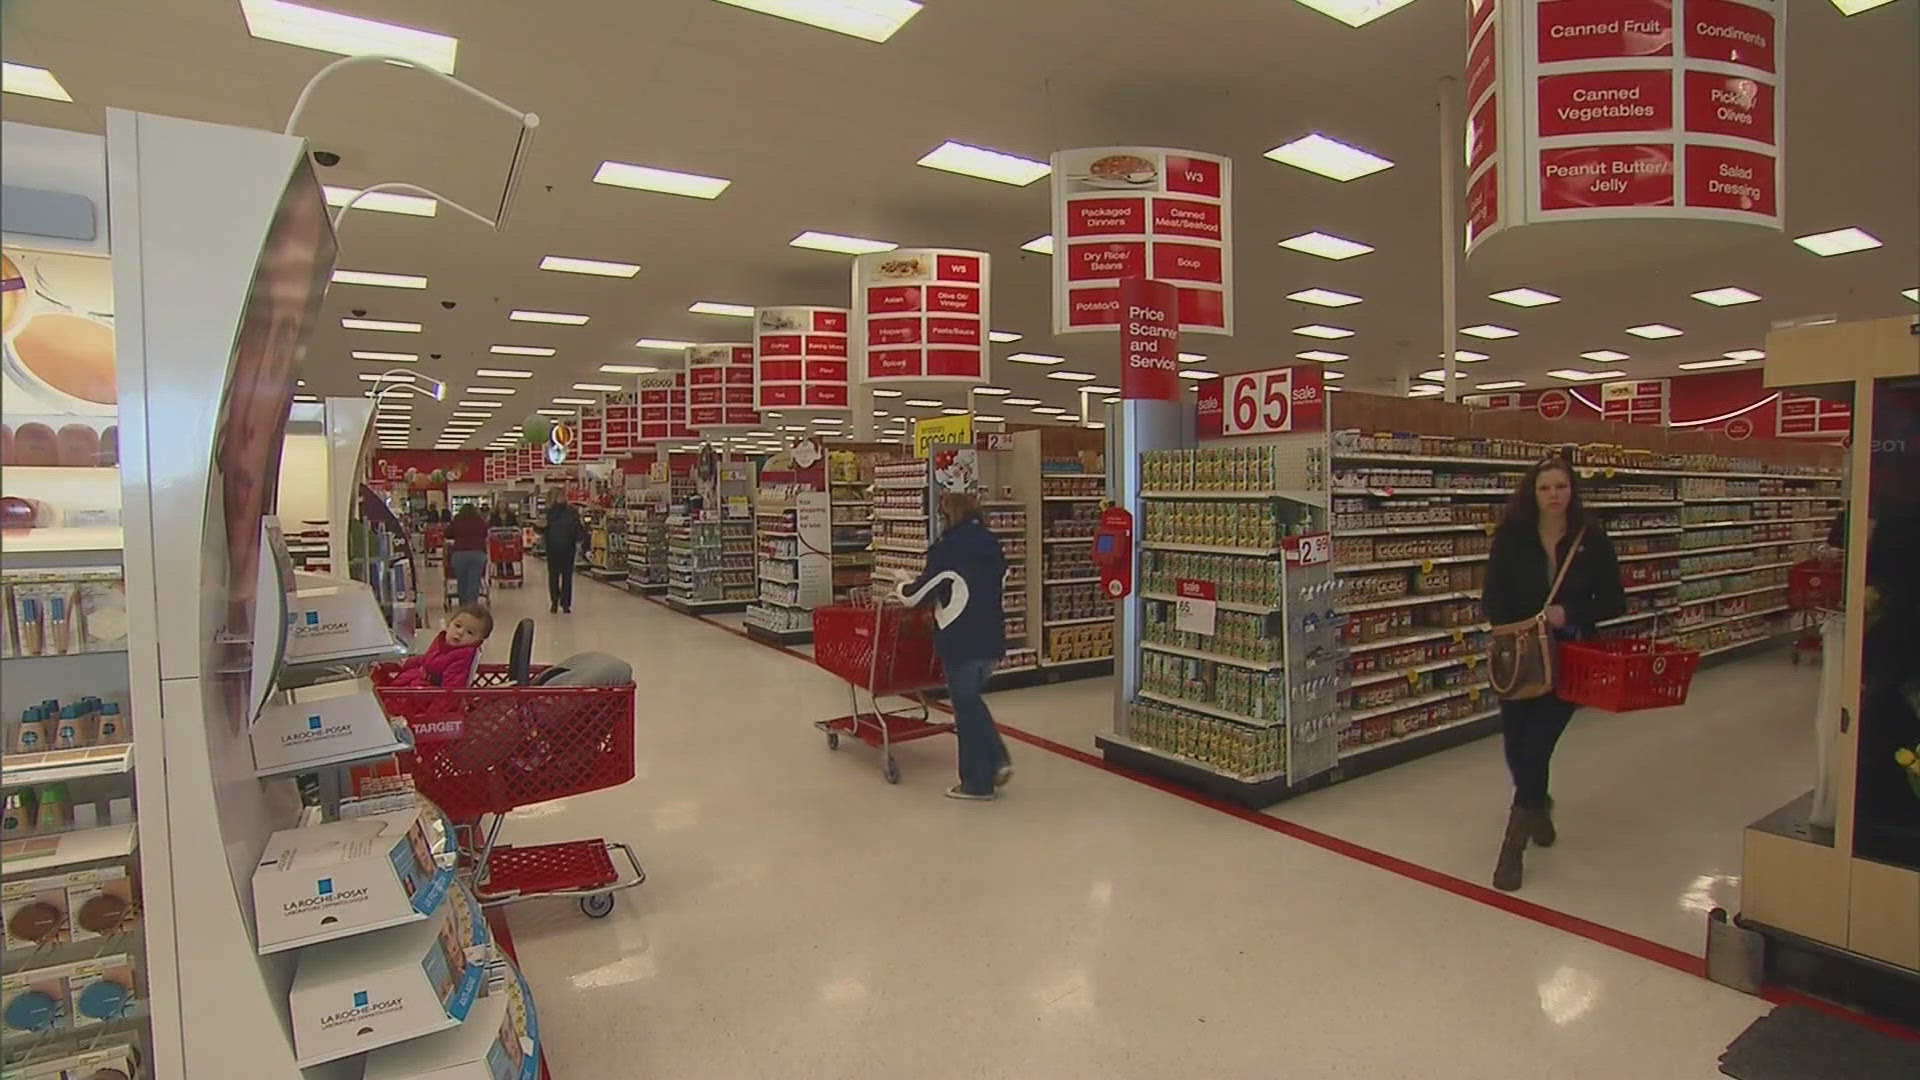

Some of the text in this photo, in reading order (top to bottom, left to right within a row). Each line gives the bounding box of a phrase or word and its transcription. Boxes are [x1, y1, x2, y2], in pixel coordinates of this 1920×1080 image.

[1550, 19, 1661, 39] Canned Fruit
[1696, 22, 1767, 48] Condiments
[1573, 87, 1640, 102] Canned
[1557, 104, 1655, 121] Vegetables
[1717, 107, 1753, 125] Olives
[1546, 159, 1668, 177] Peanut Butter/
[1719, 163, 1753, 179] Salad
[1185, 170, 1204, 183] W3
[1590, 178, 1628, 193] Jelly
[1709, 180, 1761, 200] Dressing
[1081, 207, 1131, 218] Packaged
[1170, 208, 1205, 220] Canned
[1087, 218, 1126, 227] Dinners
[1155, 217, 1218, 232] Meat/Seafood
[1084, 251, 1131, 263] Dry Rice/
[1177, 258, 1201, 269] Soup
[951, 264, 967, 274] W5
[1091, 262, 1123, 271] Beans
[939, 300, 967, 308] Vinegar
[1129, 306, 1165, 321] Price
[1129, 323, 1178, 340] Scanner
[1130, 339, 1158, 352] and
[1130, 355, 1176, 371] Service
[1292, 385, 1316, 400] sale
[1198, 396, 1218, 410] sale
[1233, 373, 1289, 432] 65
[1302, 536, 1328, 563] 2.99
[412, 720, 463, 736] TARGET
[283, 888, 368, 911] LA ROCHE-POSAY
[320, 998, 402, 1025] LA ROCHE-POSAY
